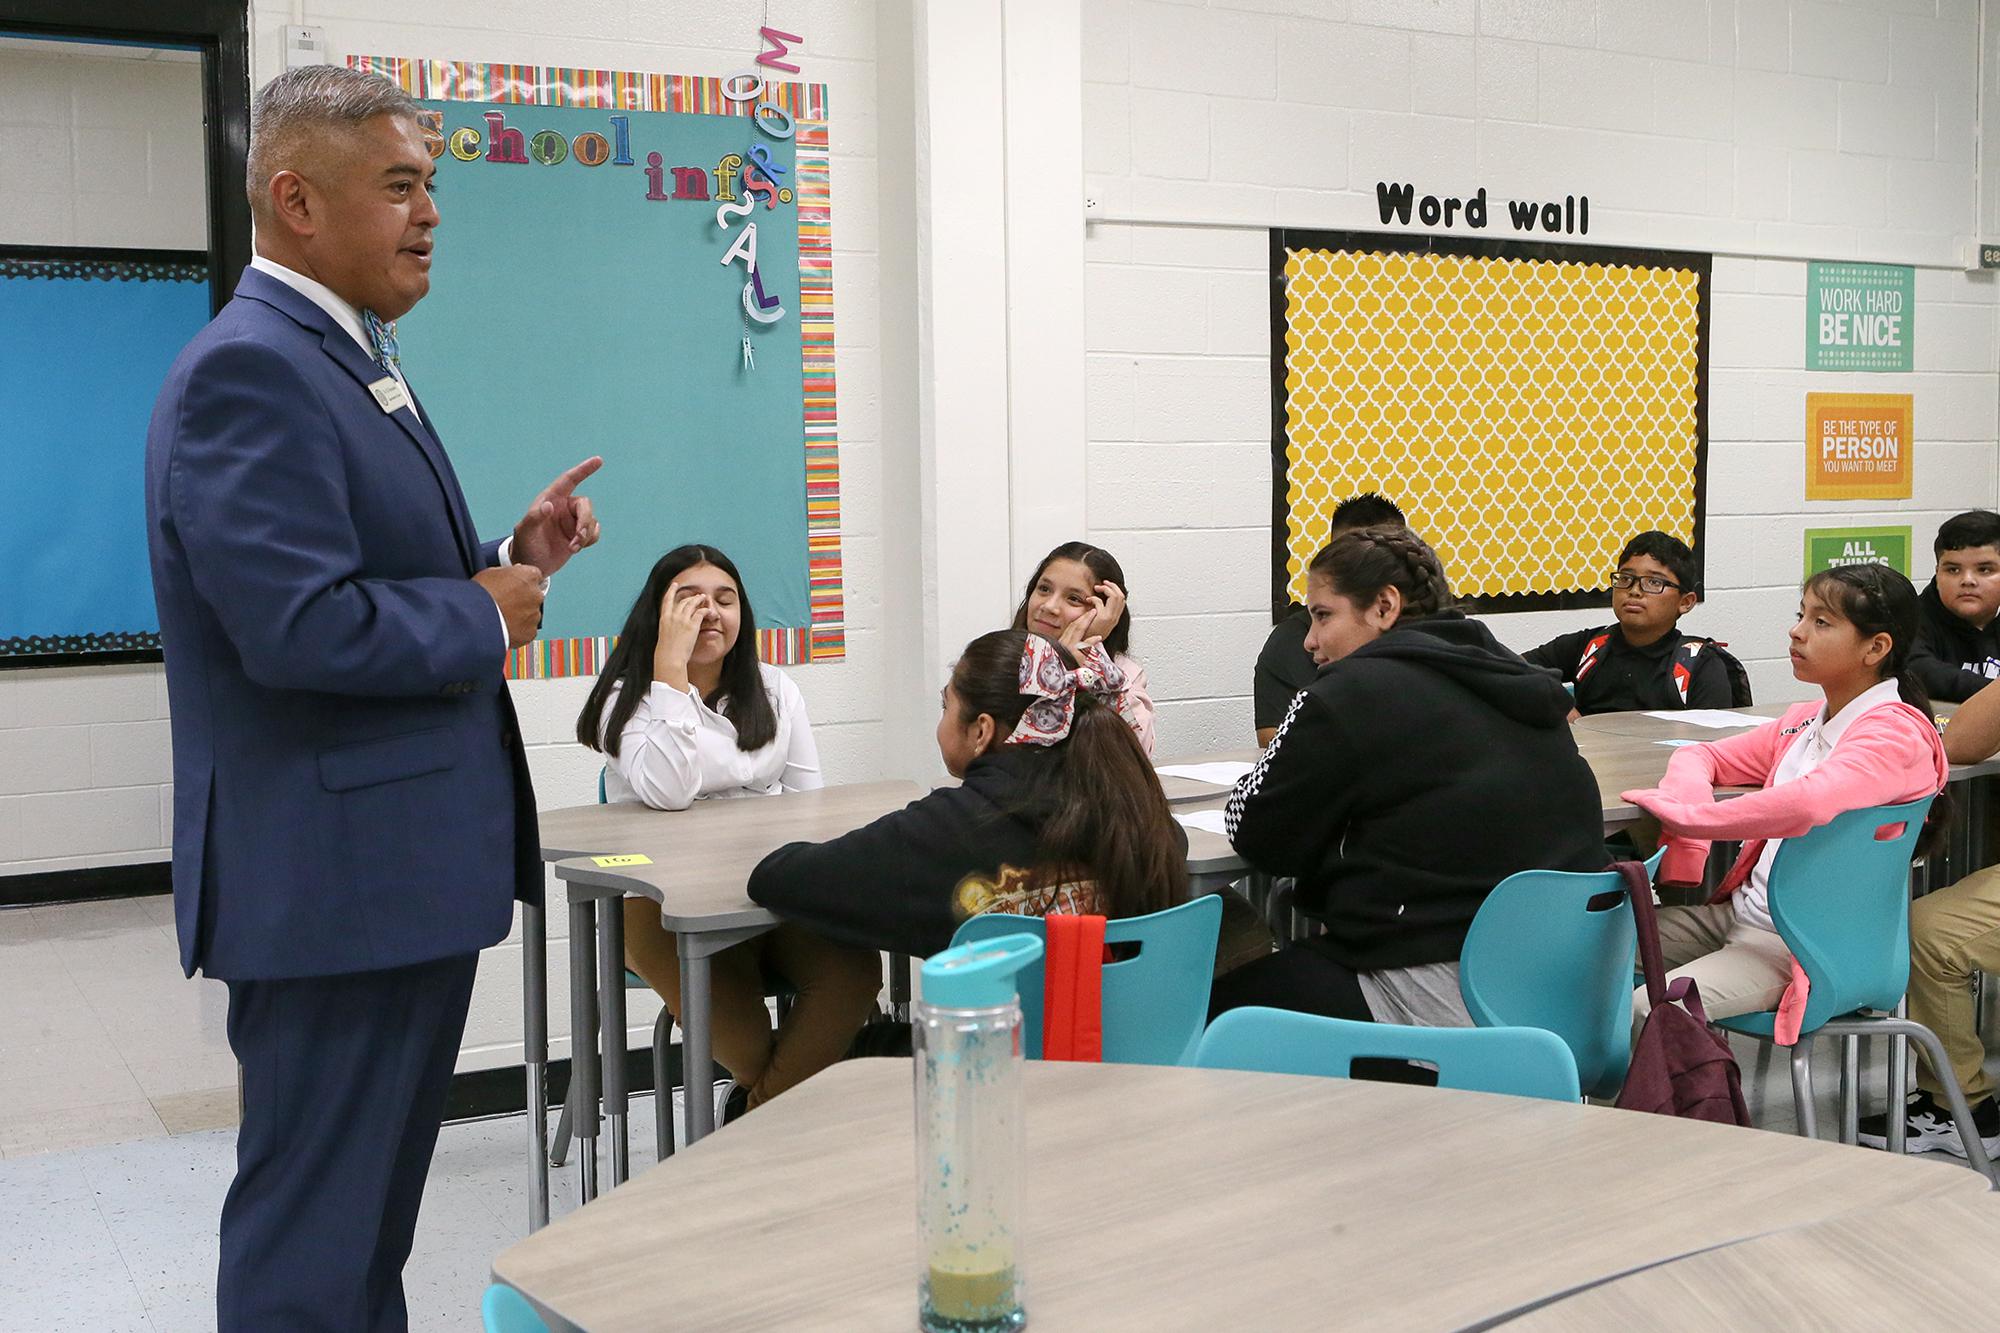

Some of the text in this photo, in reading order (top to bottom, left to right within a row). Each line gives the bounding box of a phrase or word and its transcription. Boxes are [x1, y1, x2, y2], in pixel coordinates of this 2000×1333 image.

[1376, 181, 1589, 235] Word wall
[1819, 287, 1903, 314] WORK HARD
[1819, 312, 1902, 346] BE NICE
[1823, 420, 1898, 436] BE THE TYPE OF
[1822, 436, 1899, 460] PERSON
[1823, 460, 1898, 473] YOU WANT TO MEET
[1842, 540, 1876, 557] ALL
